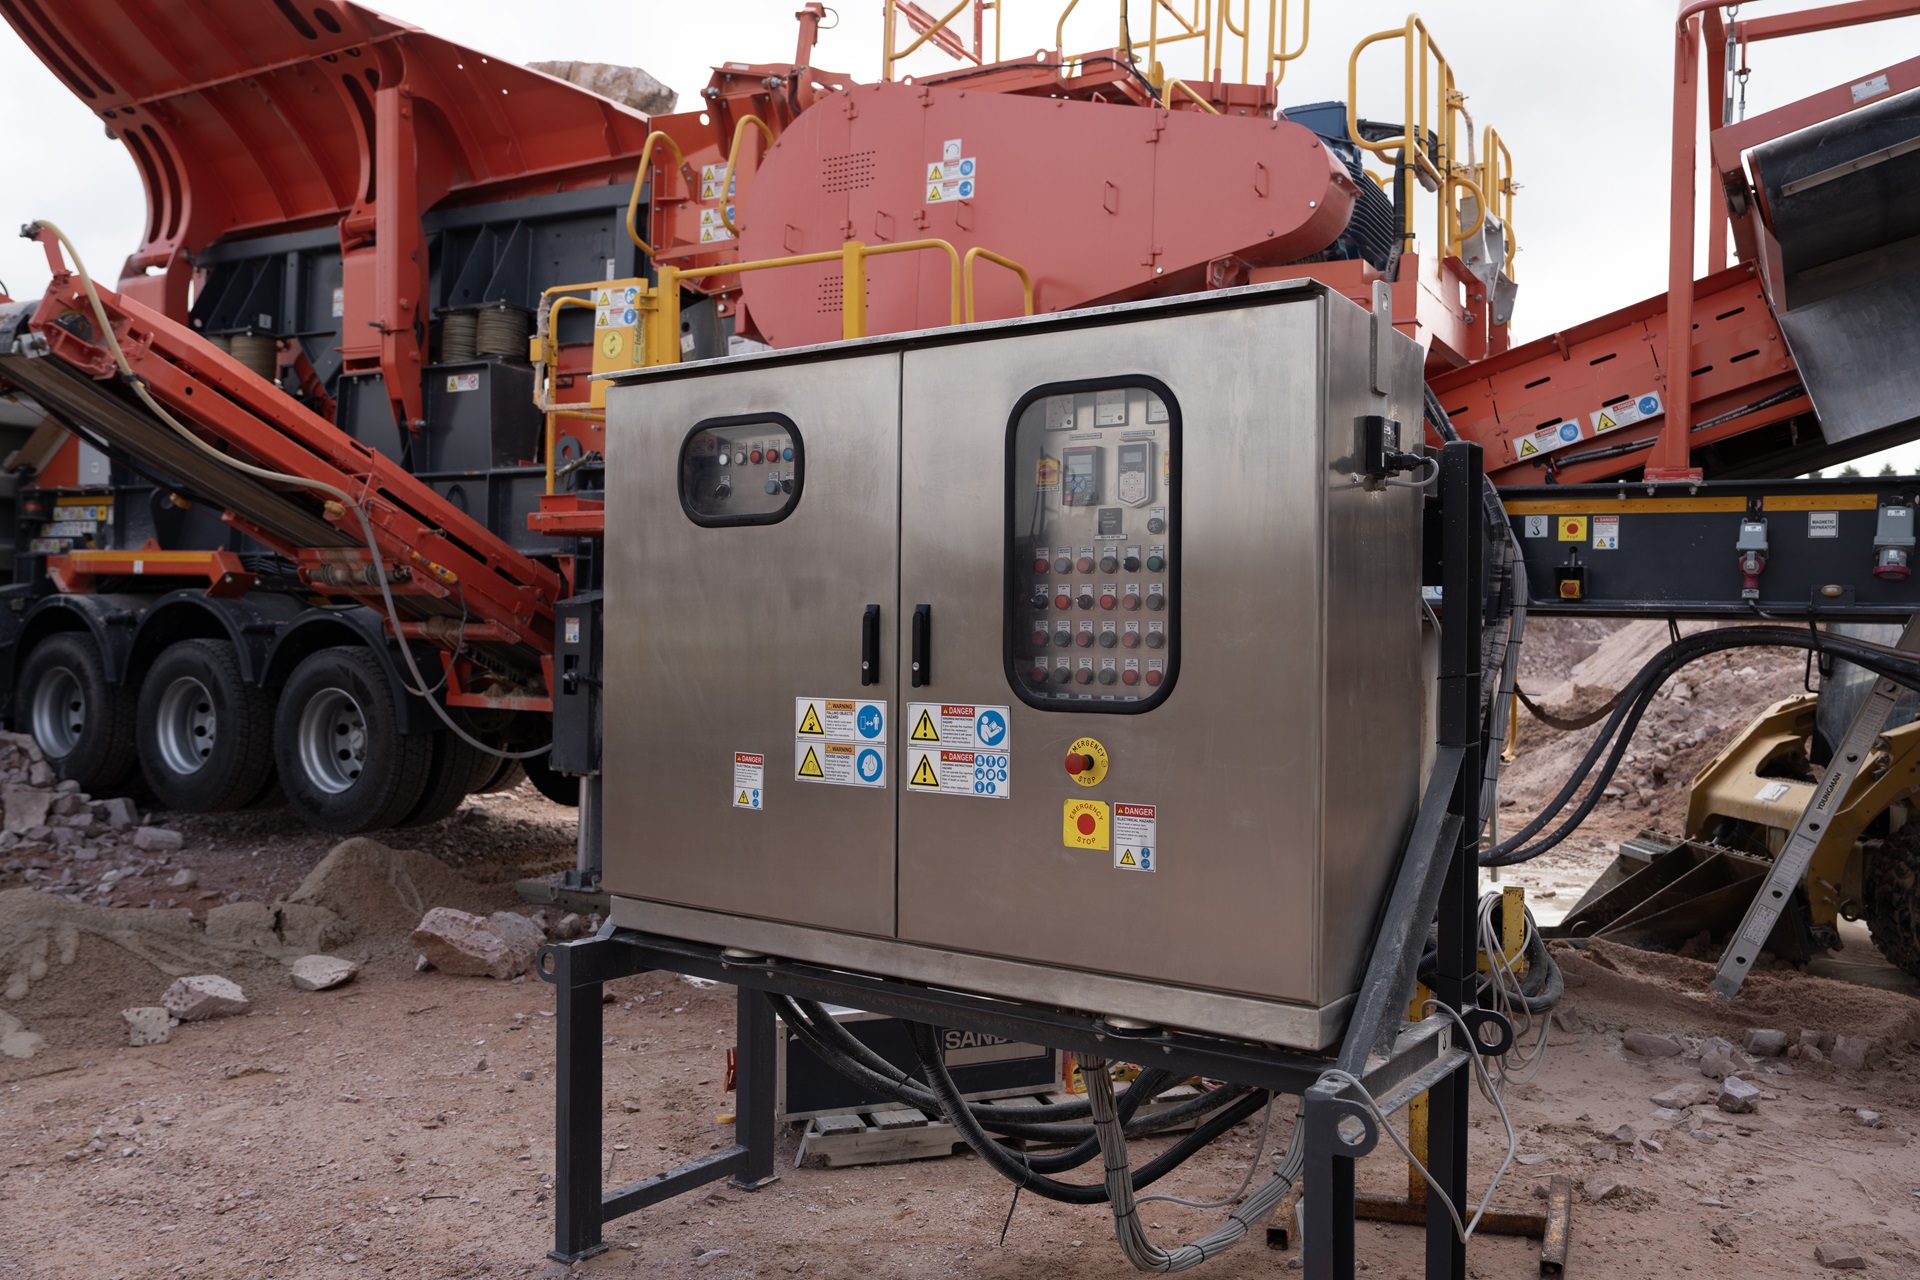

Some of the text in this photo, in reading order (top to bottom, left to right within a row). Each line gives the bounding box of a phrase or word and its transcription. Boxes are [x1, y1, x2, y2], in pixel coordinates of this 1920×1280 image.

[948, 706, 974, 715] DANGER
[1070, 740, 1105, 757] MERGENCY
[742, 755, 762, 764] DANGER
[948, 753, 973, 762] DANGER
[1078, 776, 1096, 784] STOP
[1816, 771, 1841, 810] YOUNGMAN
[1069, 803, 1104, 820] EMERGENCY
[1124, 806, 1154, 816] DANGER
[1076, 836, 1096, 844] STOP
